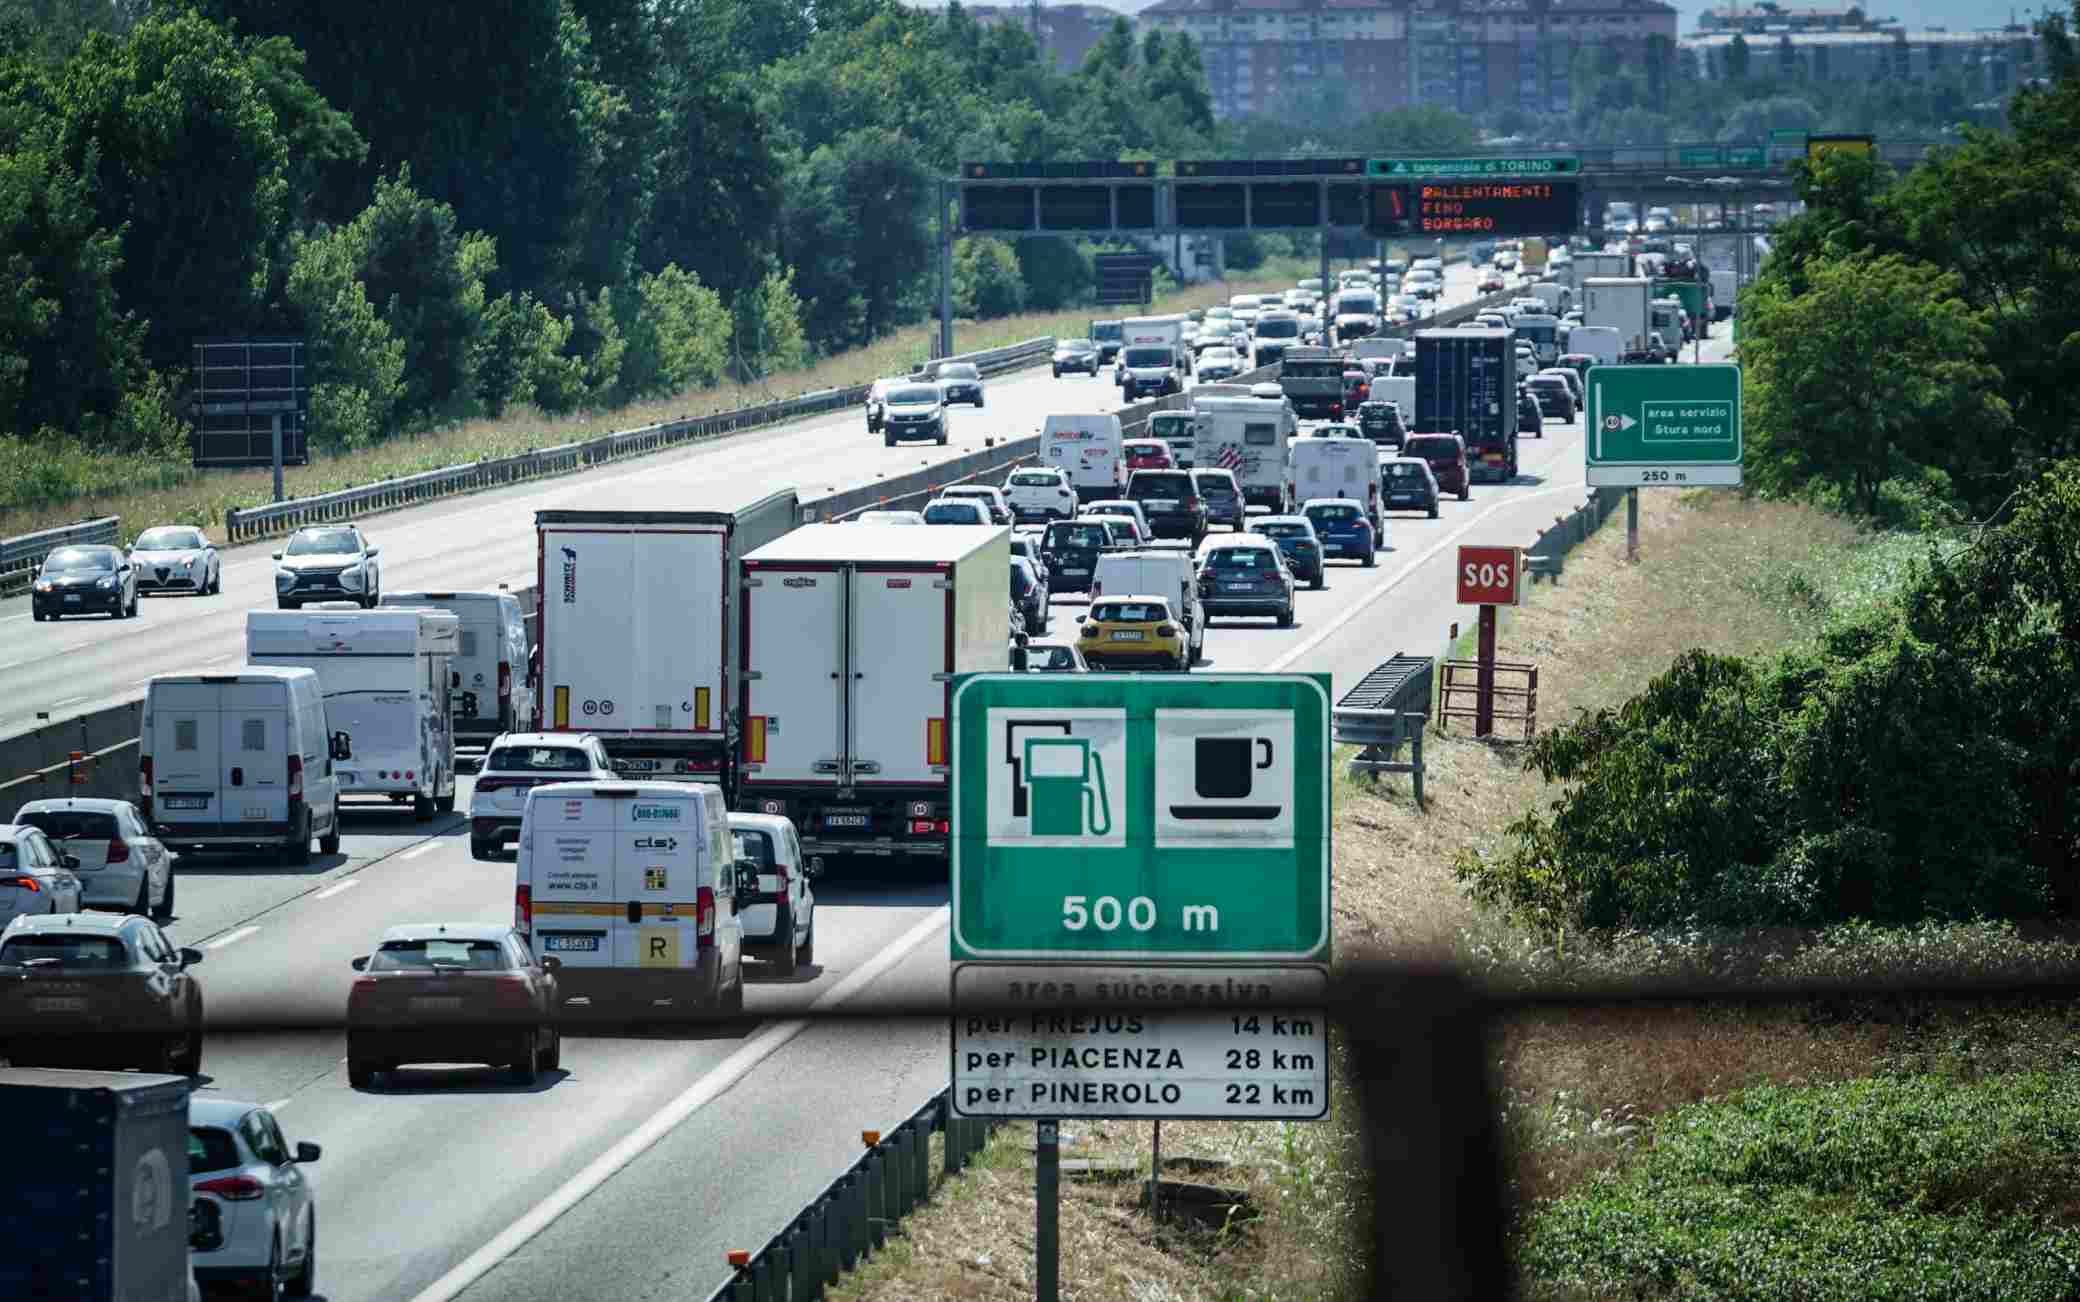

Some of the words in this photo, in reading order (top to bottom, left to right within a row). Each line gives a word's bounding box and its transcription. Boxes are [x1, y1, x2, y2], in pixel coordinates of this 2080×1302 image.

[1501, 160, 1552, 171] TORINO
[1422, 202, 1463, 214] FINO
[1422, 217, 1494, 230] BORGARO
[1648, 409, 1674, 417] area
[1680, 407, 1727, 417] servizio
[1655, 424, 1689, 434] Stura
[1693, 424, 1721, 434] nord
[1642, 471, 1669, 481] 250
[1675, 472, 1687, 481] m
[1465, 563, 1509, 588] SOS
[1062, 895, 1157, 931] 500
[1183, 904, 1218, 931] m
[650, 937, 667, 958] R
[1008, 980, 1076, 1001] area
[1096, 977, 1273, 1001] successiva
[967, 1018, 1015, 1037] per
[1231, 1014, 1262, 1035] 14
[1272, 1014, 1315, 1035] km
[967, 1053, 1015, 1071] per
[1031, 1048, 1184, 1070] PIACENZA
[1226, 1049, 1261, 1070] 28
[1272, 1049, 1315, 1070] km
[967, 1088, 1015, 1106] per
[1031, 1083, 1182, 1104] PINEROLO
[1226, 1083, 1261, 1104] 22
[1272, 1083, 1315, 1104] km
